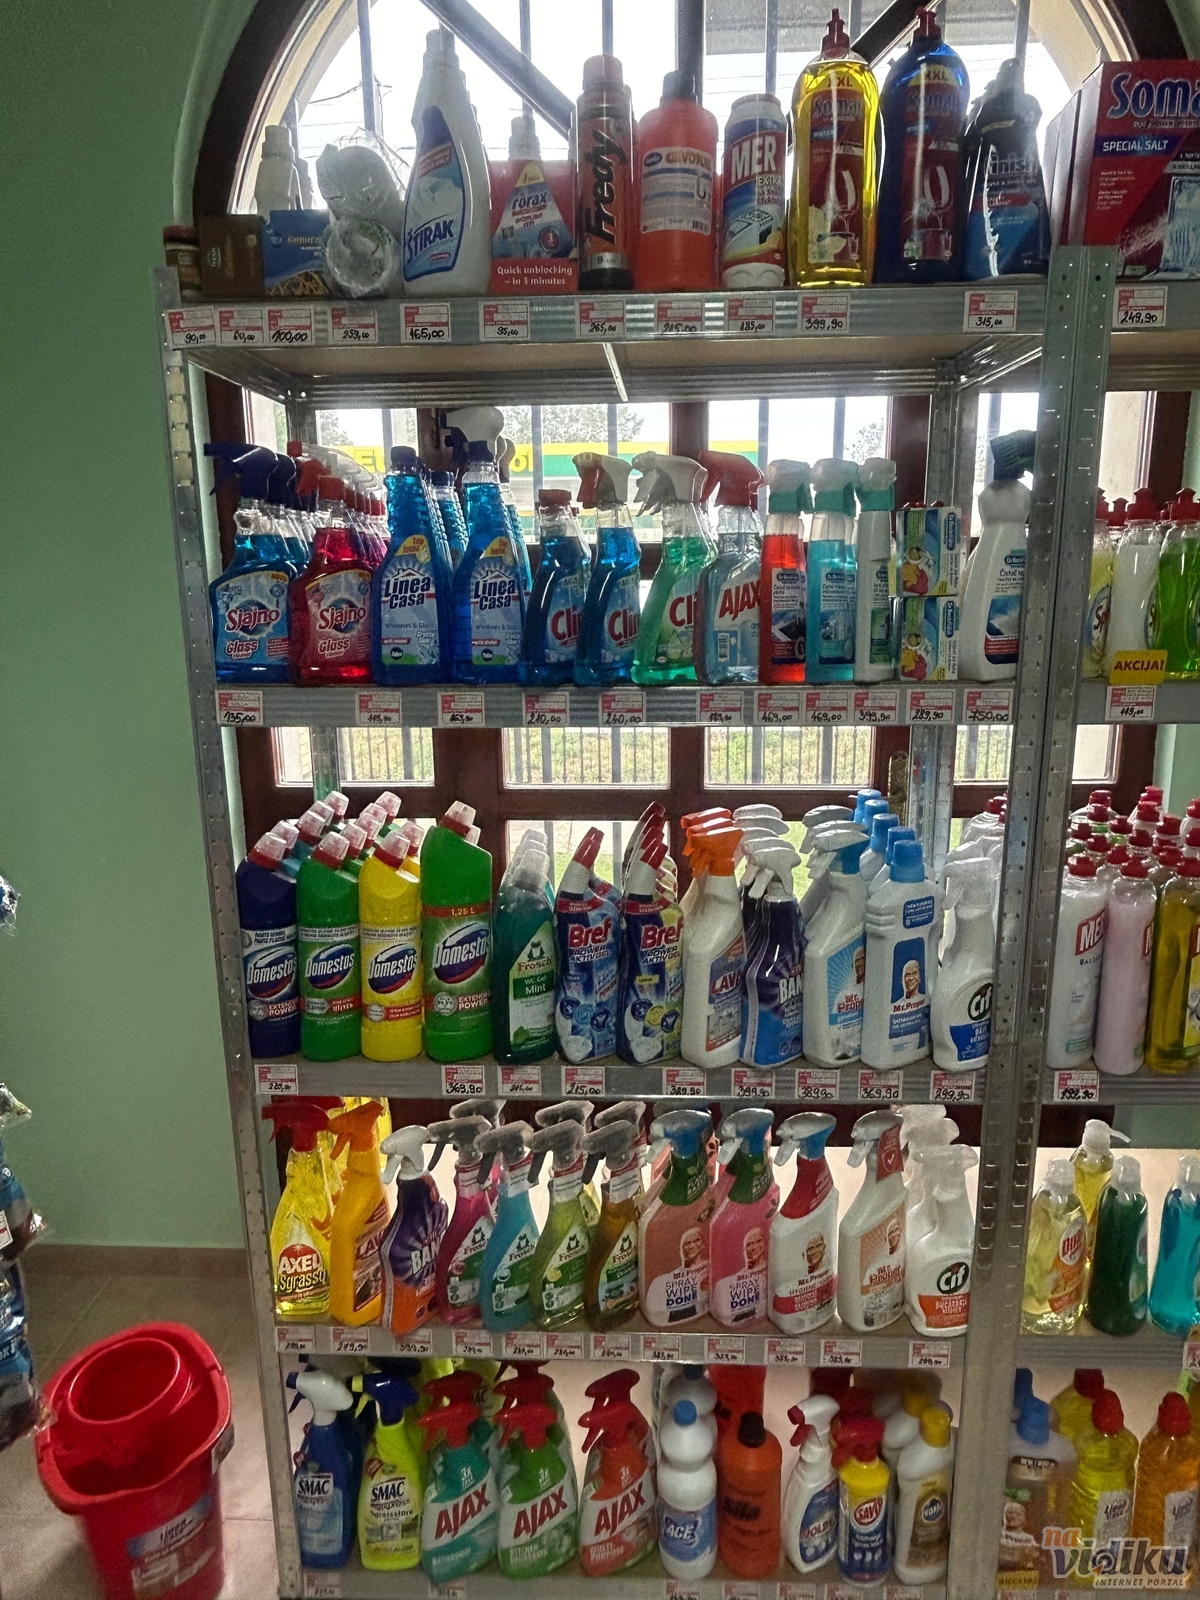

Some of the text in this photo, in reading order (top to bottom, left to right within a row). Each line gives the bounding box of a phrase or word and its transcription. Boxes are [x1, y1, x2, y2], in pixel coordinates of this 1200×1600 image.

[1106, 72, 1200, 120] Som
[1103, 139, 1168, 151] SPECIAL SALT
[731, 135, 777, 184] MER
[497, 265, 572, 276] Quick unblocking
[531, 277, 566, 285] minutes
[384, 577, 431, 597] Linea
[474, 578, 516, 598] Linea
[719, 578, 761, 621] AJAX
[225, 603, 281, 632] Sjajno
[318, 602, 367, 630] Sjajno
[226, 639, 259, 655] Glass
[318, 638, 350, 654] Glass
[1113, 659, 1165, 672] AKCIJA!
[568, 917, 612, 948] Bref
[641, 917, 684, 949] Bref
[247, 956, 298, 985] Domestos
[305, 952, 355, 978] Domestos
[369, 952, 418, 978] Domestos
[517, 956, 552, 972] Frosch
[525, 983, 546, 996] Mint
[458, 998, 489, 1010] POWER
[279, 1254, 322, 1274] AXEL
[279, 1270, 326, 1293] Sgrasso
[665, 1276, 698, 1291] SPRAY
[729, 1278, 760, 1293] SPRAY
[940, 1264, 967, 1293] Cif
[666, 1285, 697, 1299] WIPE
[666, 1292, 698, 1308] DONE
[730, 1294, 760, 1310] DONE
[299, 1479, 330, 1496] SMAC
[371, 1482, 405, 1503] SMAC
[435, 1483, 491, 1540] AJAX
[513, 1486, 568, 1539] AJAX
[594, 1481, 646, 1537] AJAX
